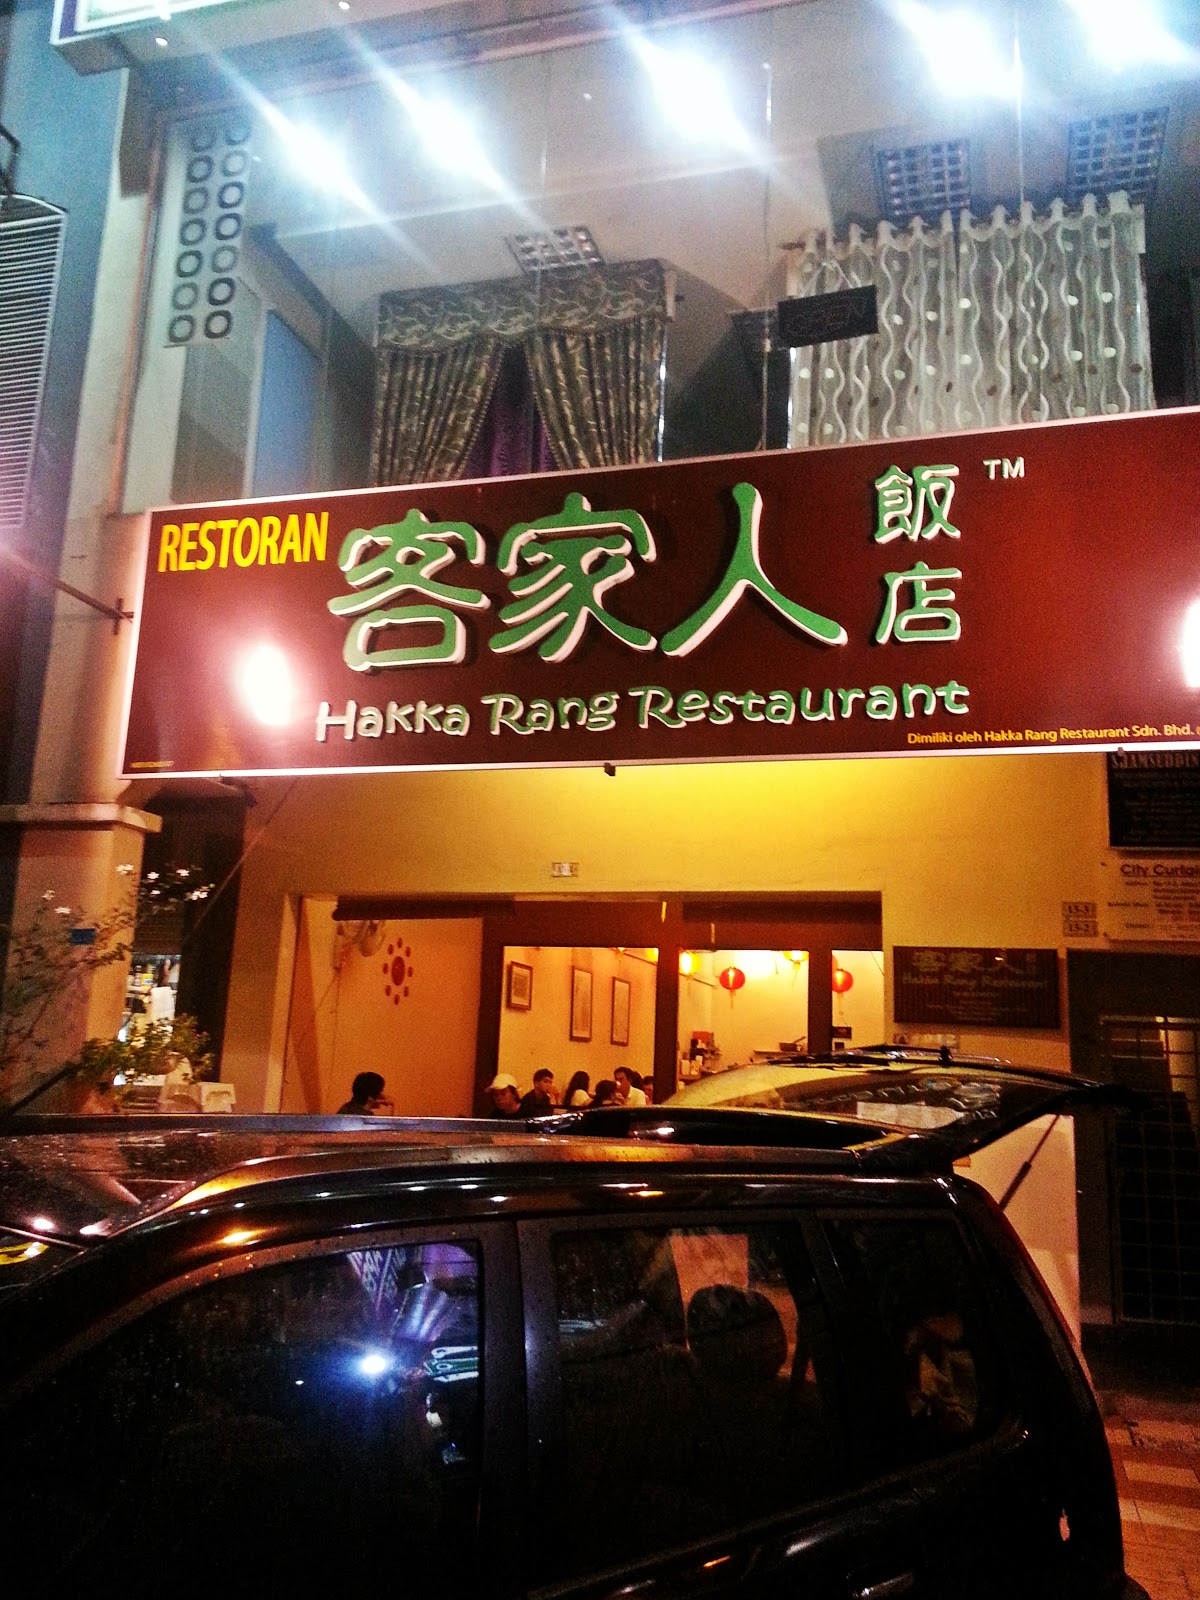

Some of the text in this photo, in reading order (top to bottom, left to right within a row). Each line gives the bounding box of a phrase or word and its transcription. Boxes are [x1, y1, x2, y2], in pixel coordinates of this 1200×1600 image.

[983, 456, 1025, 480] TM
[158, 511, 329, 573] RESTORAN
[874, 464, 963, 645] 飯店
[328, 482, 849, 671] 客家人
[315, 680, 970, 742] Hakka Rang Restaurant
[907, 732, 953, 744] Dimiliki
[955, 731, 982, 743] oleh
[984, 730, 1023, 742] Hakka
[1024, 729, 1058, 743] Rang
[1060, 727, 1130, 739] Restaurant
[1132, 725, 1162, 737] Sdn.
[1164, 723, 1195, 736] Bhd.
